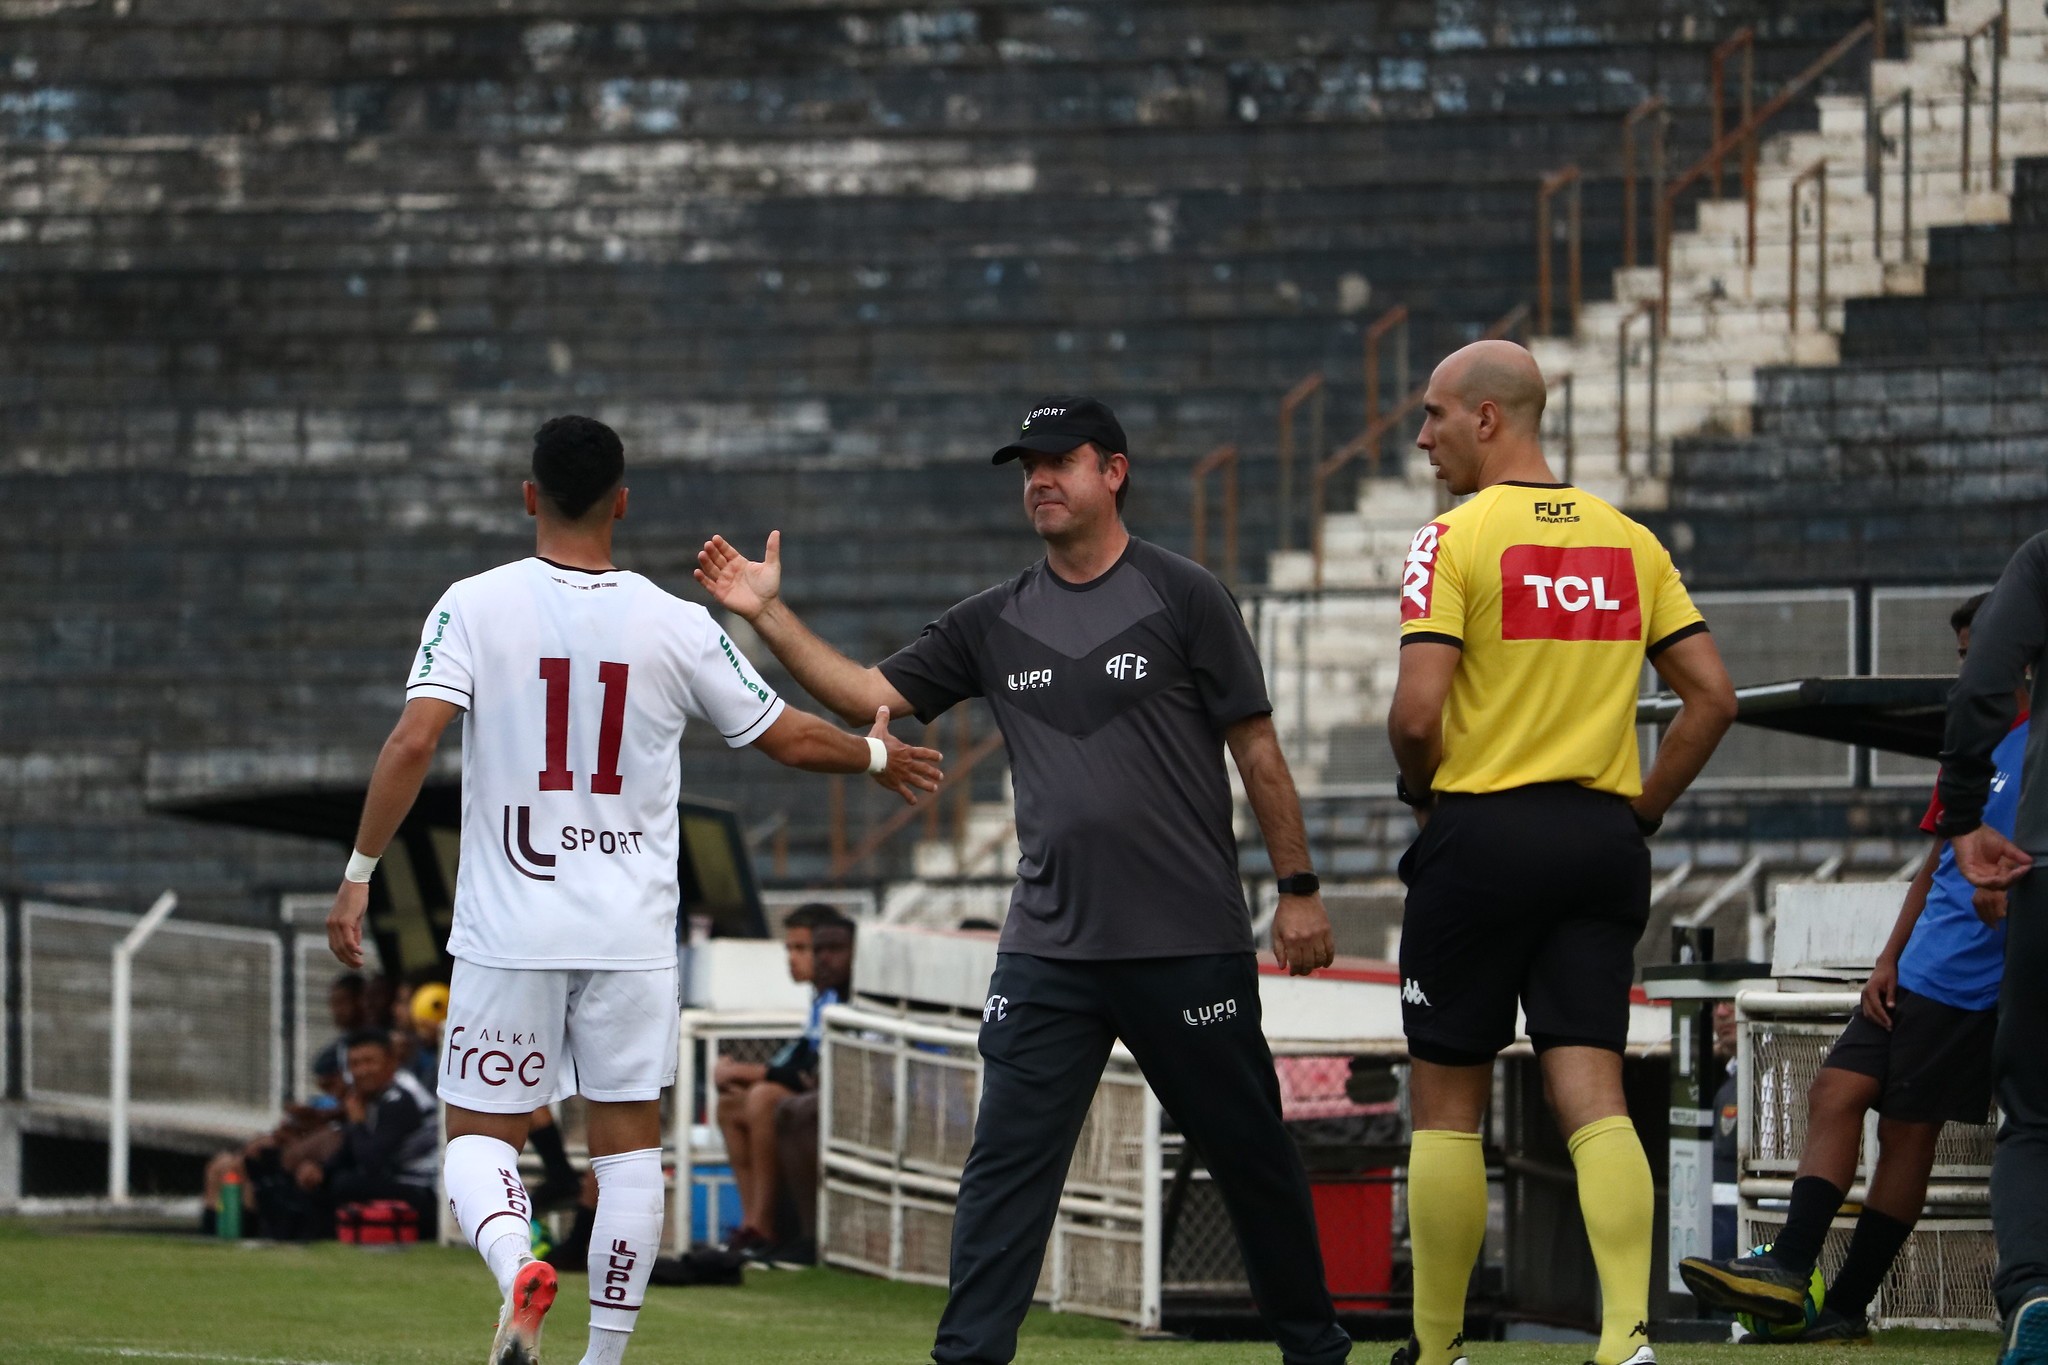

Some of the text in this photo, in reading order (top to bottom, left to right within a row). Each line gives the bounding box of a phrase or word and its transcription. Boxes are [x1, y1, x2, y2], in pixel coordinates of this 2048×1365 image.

[1031, 407, 1067, 419] SPORT
[1534, 502, 1577, 517] FUT
[1536, 514, 1581, 524] FANATICS
[1403, 524, 1438, 611] SKY
[1523, 574, 1620, 612] TCL
[1007, 668, 1053, 691] LUPO
[1105, 652, 1149, 680] AFE
[538, 657, 629, 795] 11
[561, 826, 643, 855] SPORT
[982, 994, 1009, 1023] AFE
[1182, 998, 1237, 1026] LUPO
[1201, 1011, 1238, 1026] SPORT
[479, 1028, 536, 1046] ALKA
[604, 1238, 637, 1301] LUPO
